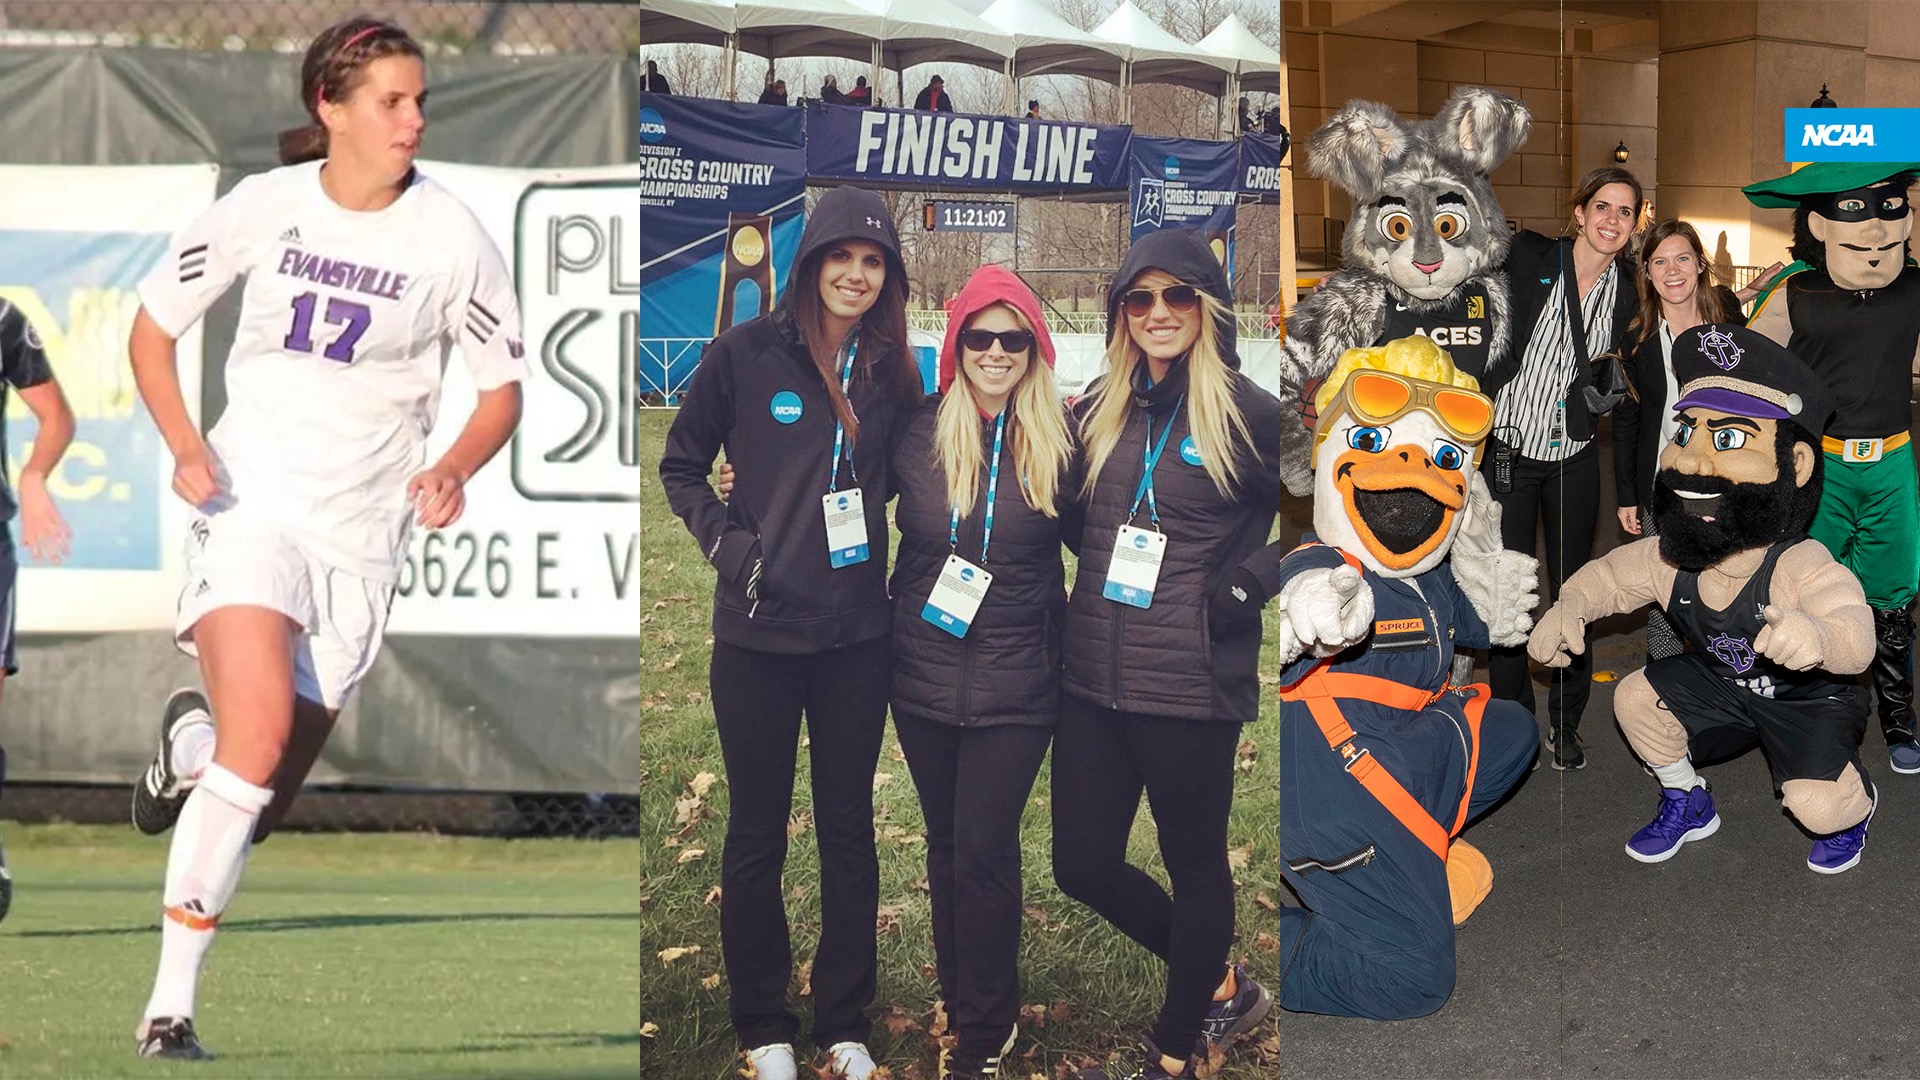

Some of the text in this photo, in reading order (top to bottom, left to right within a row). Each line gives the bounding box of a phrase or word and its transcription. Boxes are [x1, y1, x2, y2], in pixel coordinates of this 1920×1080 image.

[640, 122, 667, 134] NCAA
[676, 147, 682, 157] I
[855, 110, 1097, 184] FINISH LINE
[640, 157, 774, 186] CROSS COUNTRY
[1165, 189, 1237, 205] CROSS COUNTRY
[944, 207, 1007, 227] 11:21:02
[547, 214, 640, 295] PL
[277, 248, 408, 301] EVANSVILLE
[284, 291, 373, 364] 17
[775, 406, 802, 416] NCAA
[1183, 446, 1200, 457] NC
[536, 531, 579, 599] E.
[1380, 621, 1422, 631] SPRUCE
